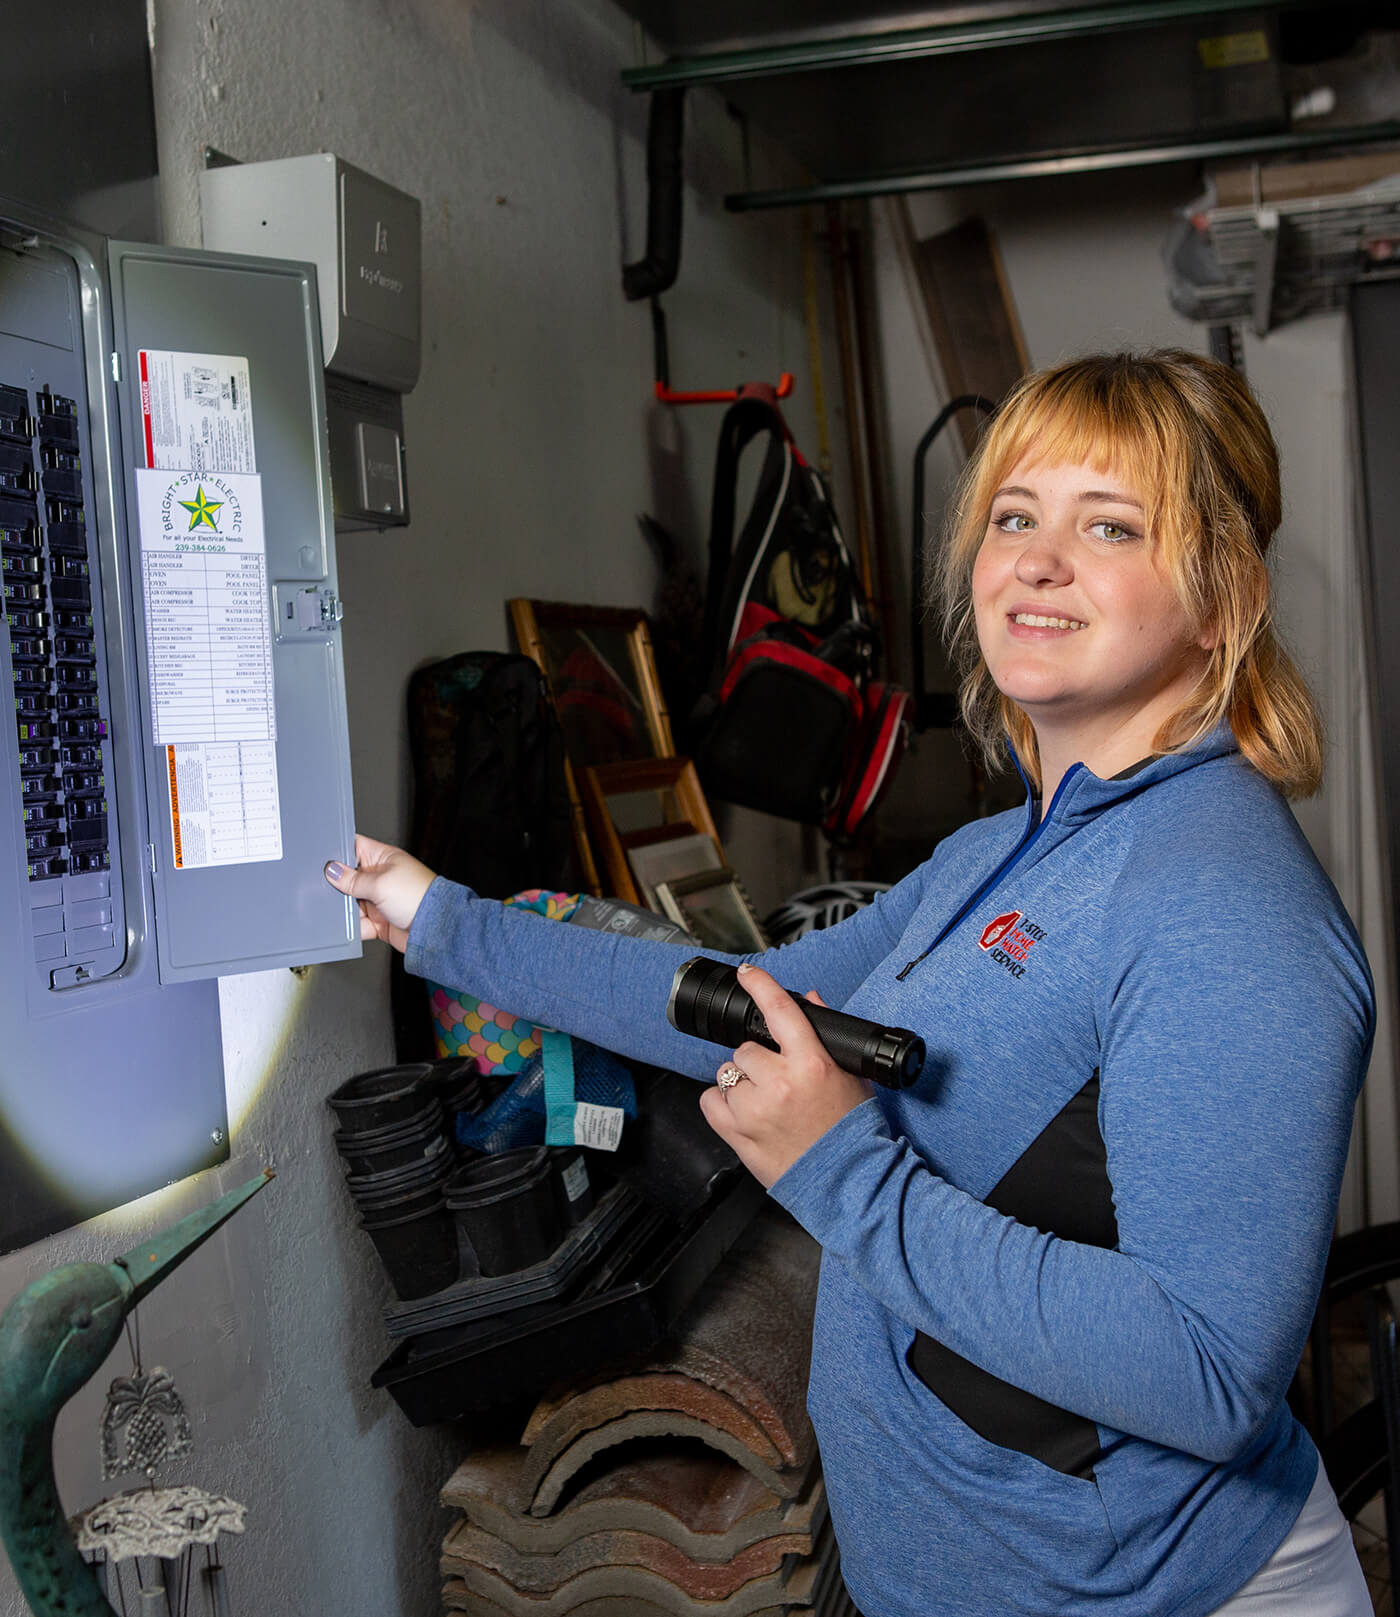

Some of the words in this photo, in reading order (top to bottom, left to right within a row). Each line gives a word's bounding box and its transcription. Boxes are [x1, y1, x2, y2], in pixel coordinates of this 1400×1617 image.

[142, 381, 151, 415] DANGER
[161, 484, 177, 531] BRIGHT
[180, 472, 208, 486] STAR
[215, 479, 242, 533] ELECTRIC
[175, 544, 226, 552] 239-384-0626
[168, 758, 179, 813] ADVERTENCIA
[174, 818, 183, 856] WARNING
[1000, 937, 1031, 965] WATCH
[1009, 927, 1036, 952] HOME
[990, 948, 1027, 980] SERVICE
